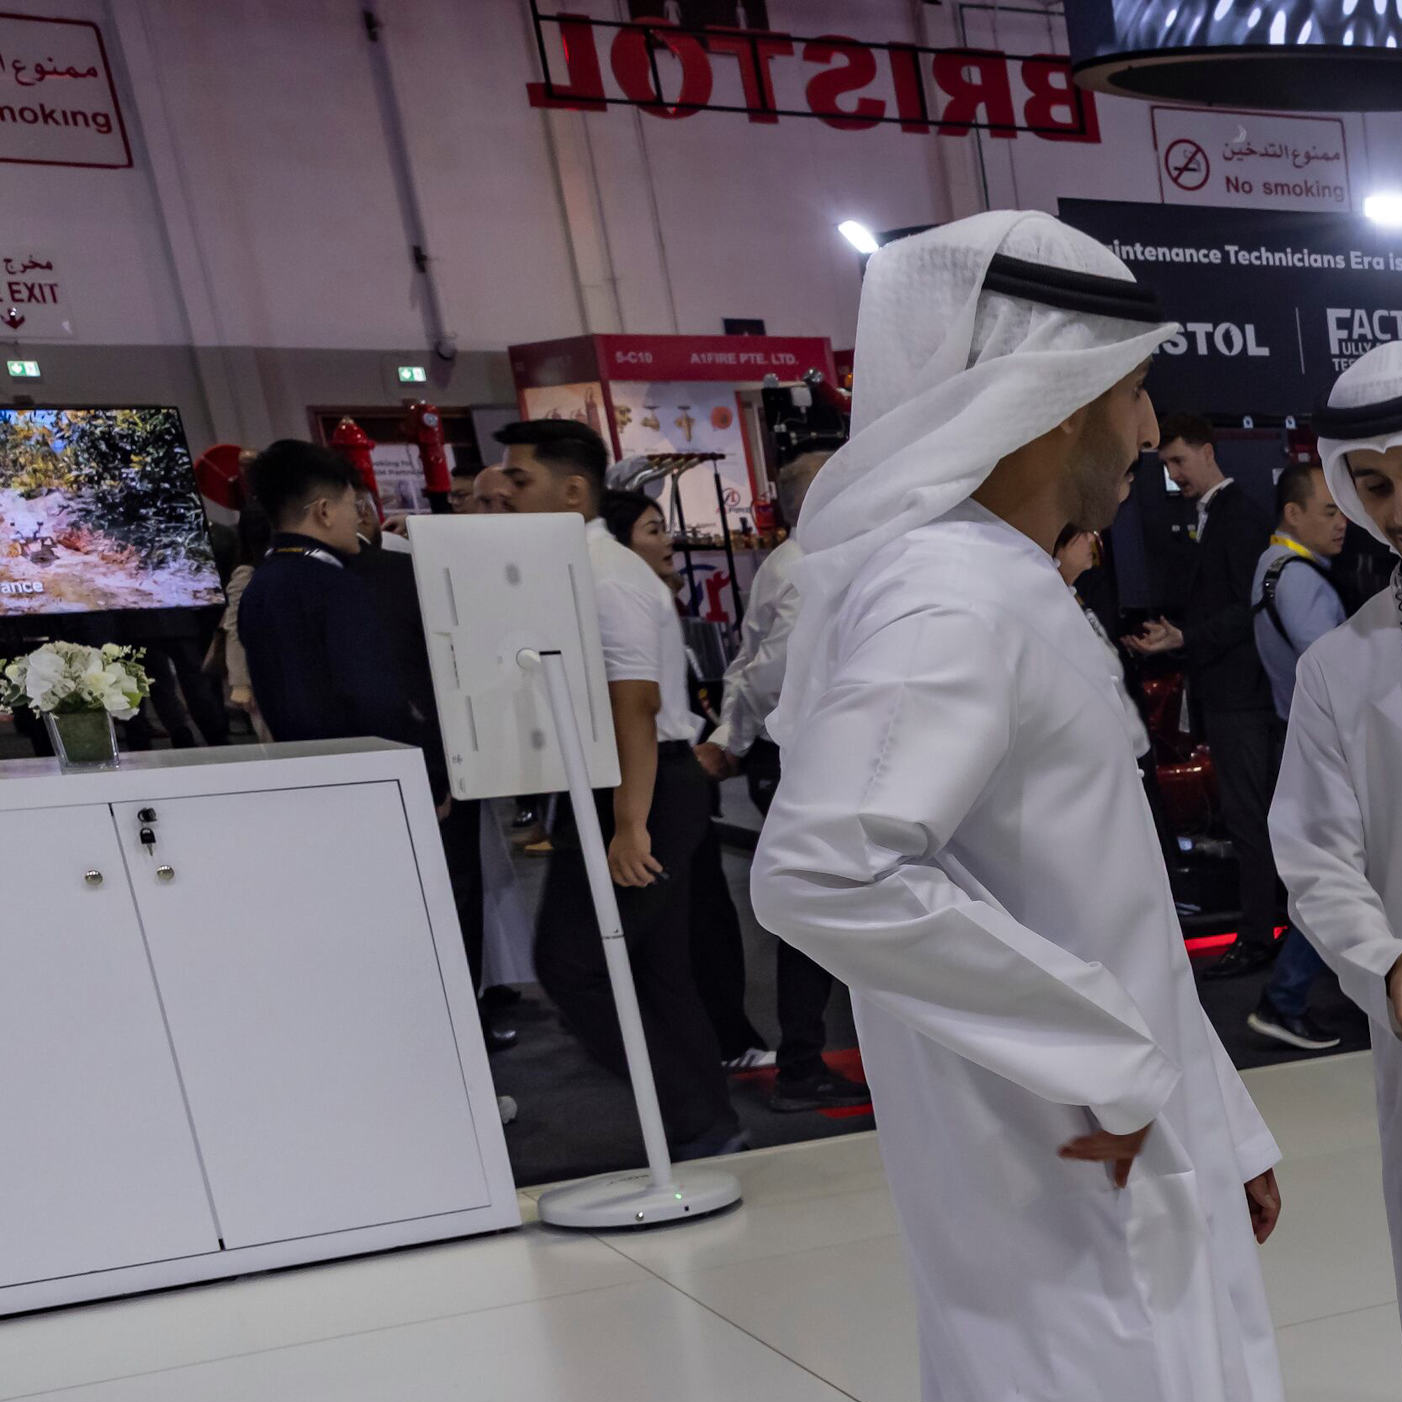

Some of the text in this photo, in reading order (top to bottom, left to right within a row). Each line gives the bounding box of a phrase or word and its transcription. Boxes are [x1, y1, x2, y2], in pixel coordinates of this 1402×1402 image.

[0, 102, 112, 134] moking
[1291, 146, 1341, 168] ممنوع
[1225, 176, 1345, 202] No smoking
[1223, 244, 1345, 269] Technicians
[1350, 250, 1385, 270] Era
[7, 281, 58, 304] EXIT
[0, 581, 44, 594] ance
